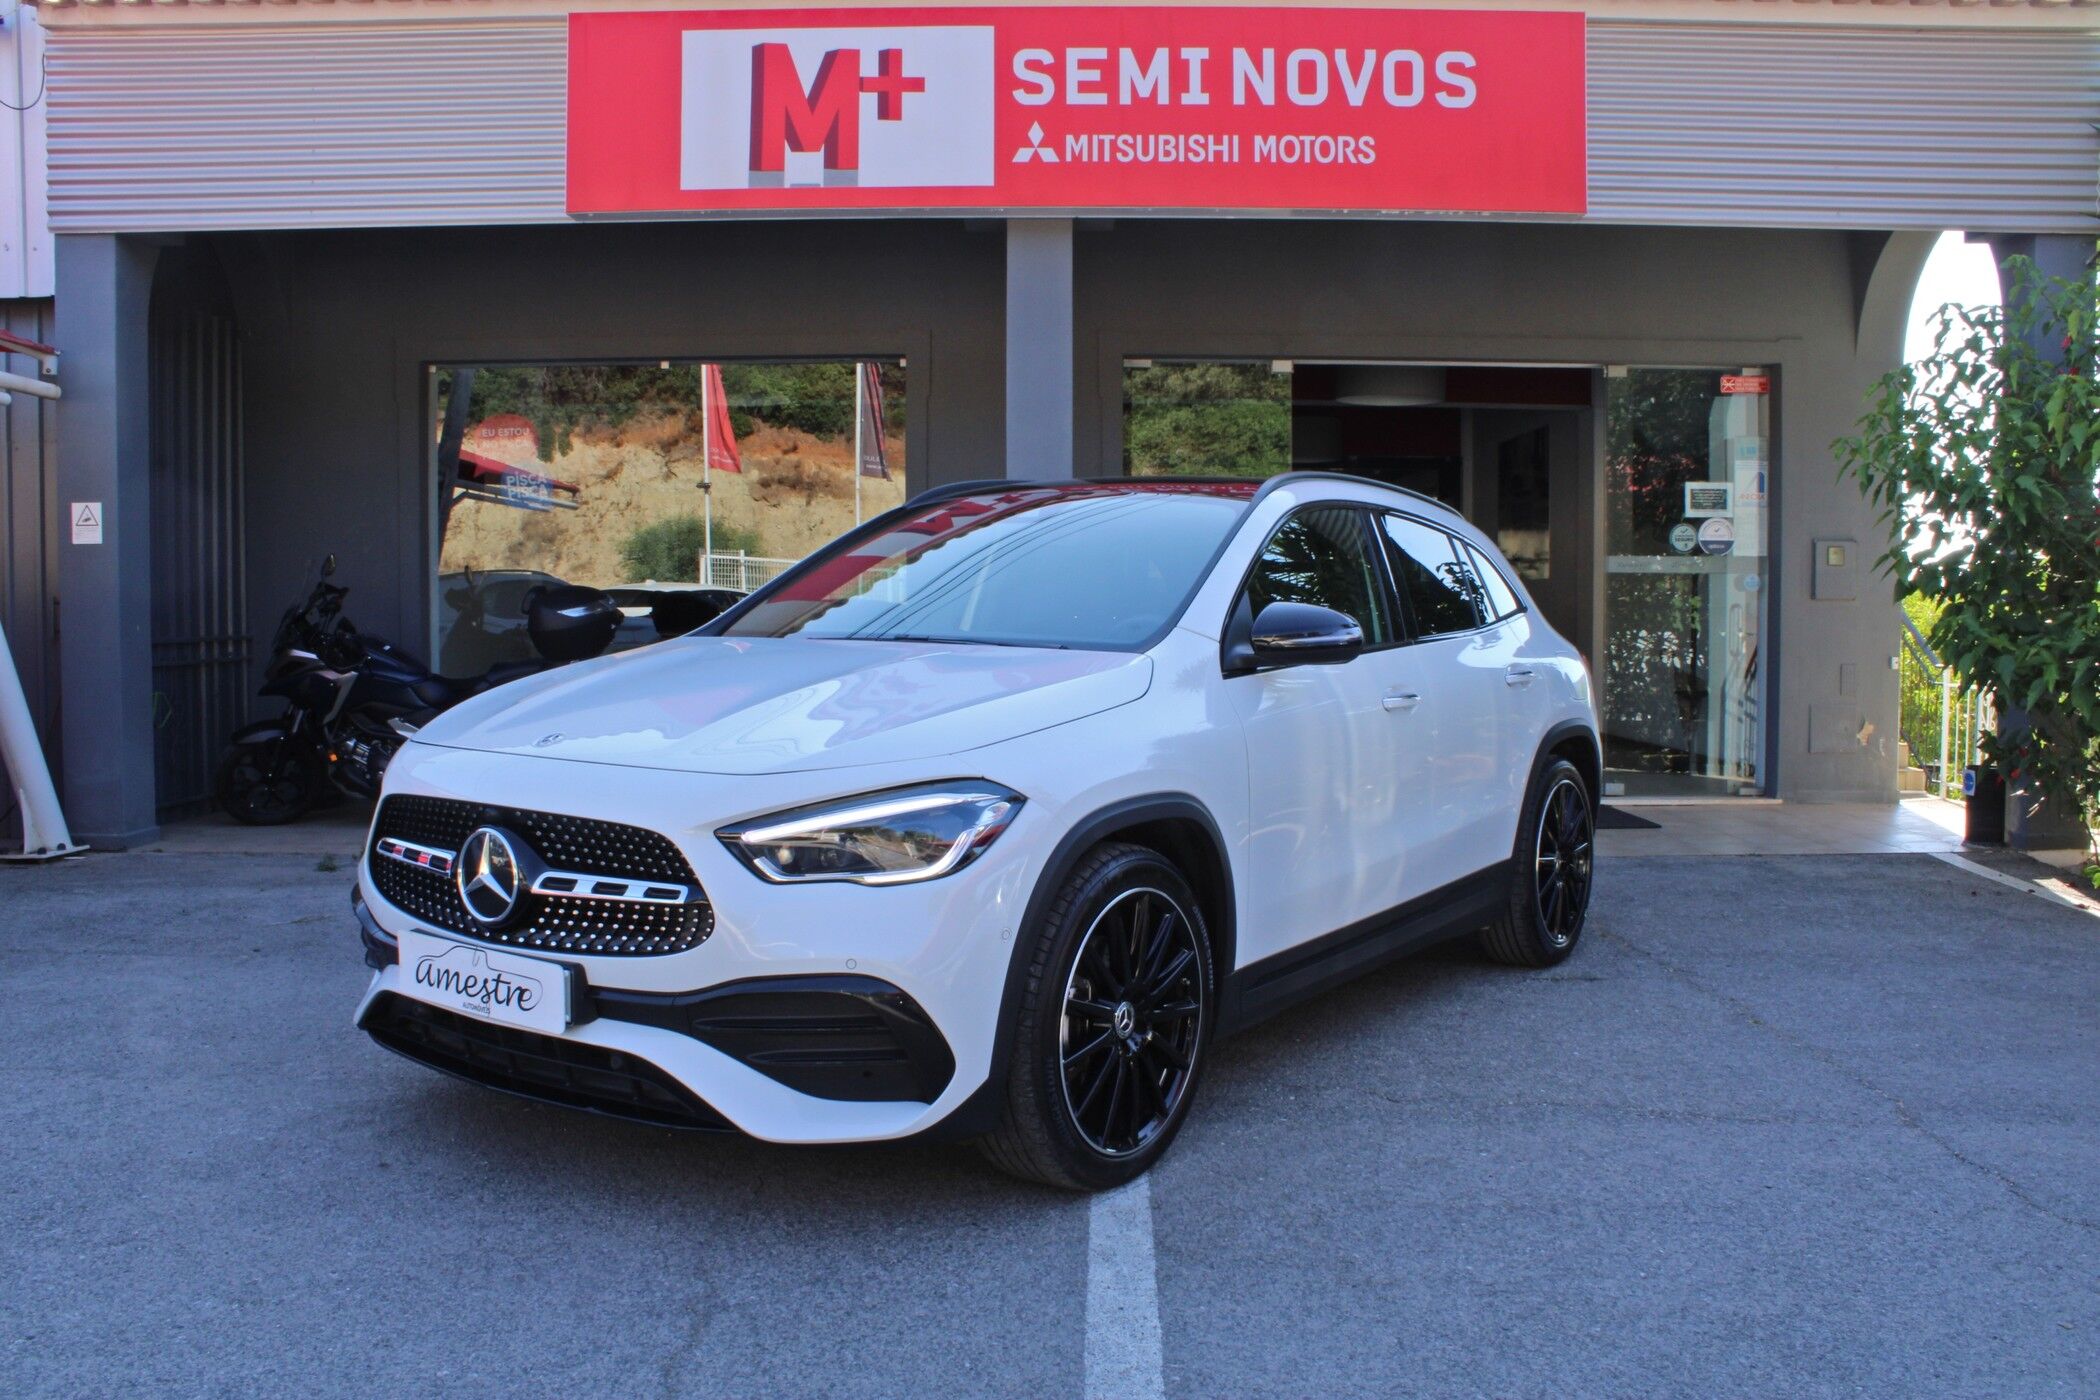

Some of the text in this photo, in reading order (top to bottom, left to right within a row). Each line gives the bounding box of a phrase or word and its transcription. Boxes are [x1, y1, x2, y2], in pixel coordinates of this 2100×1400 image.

[1012, 47, 1477, 108] SEMI NOVOS
[749, 43, 925, 171] M+
[1065, 134, 1376, 164] MITSUBISHI MOTORS
[498, 427, 530, 436] ESTOU
